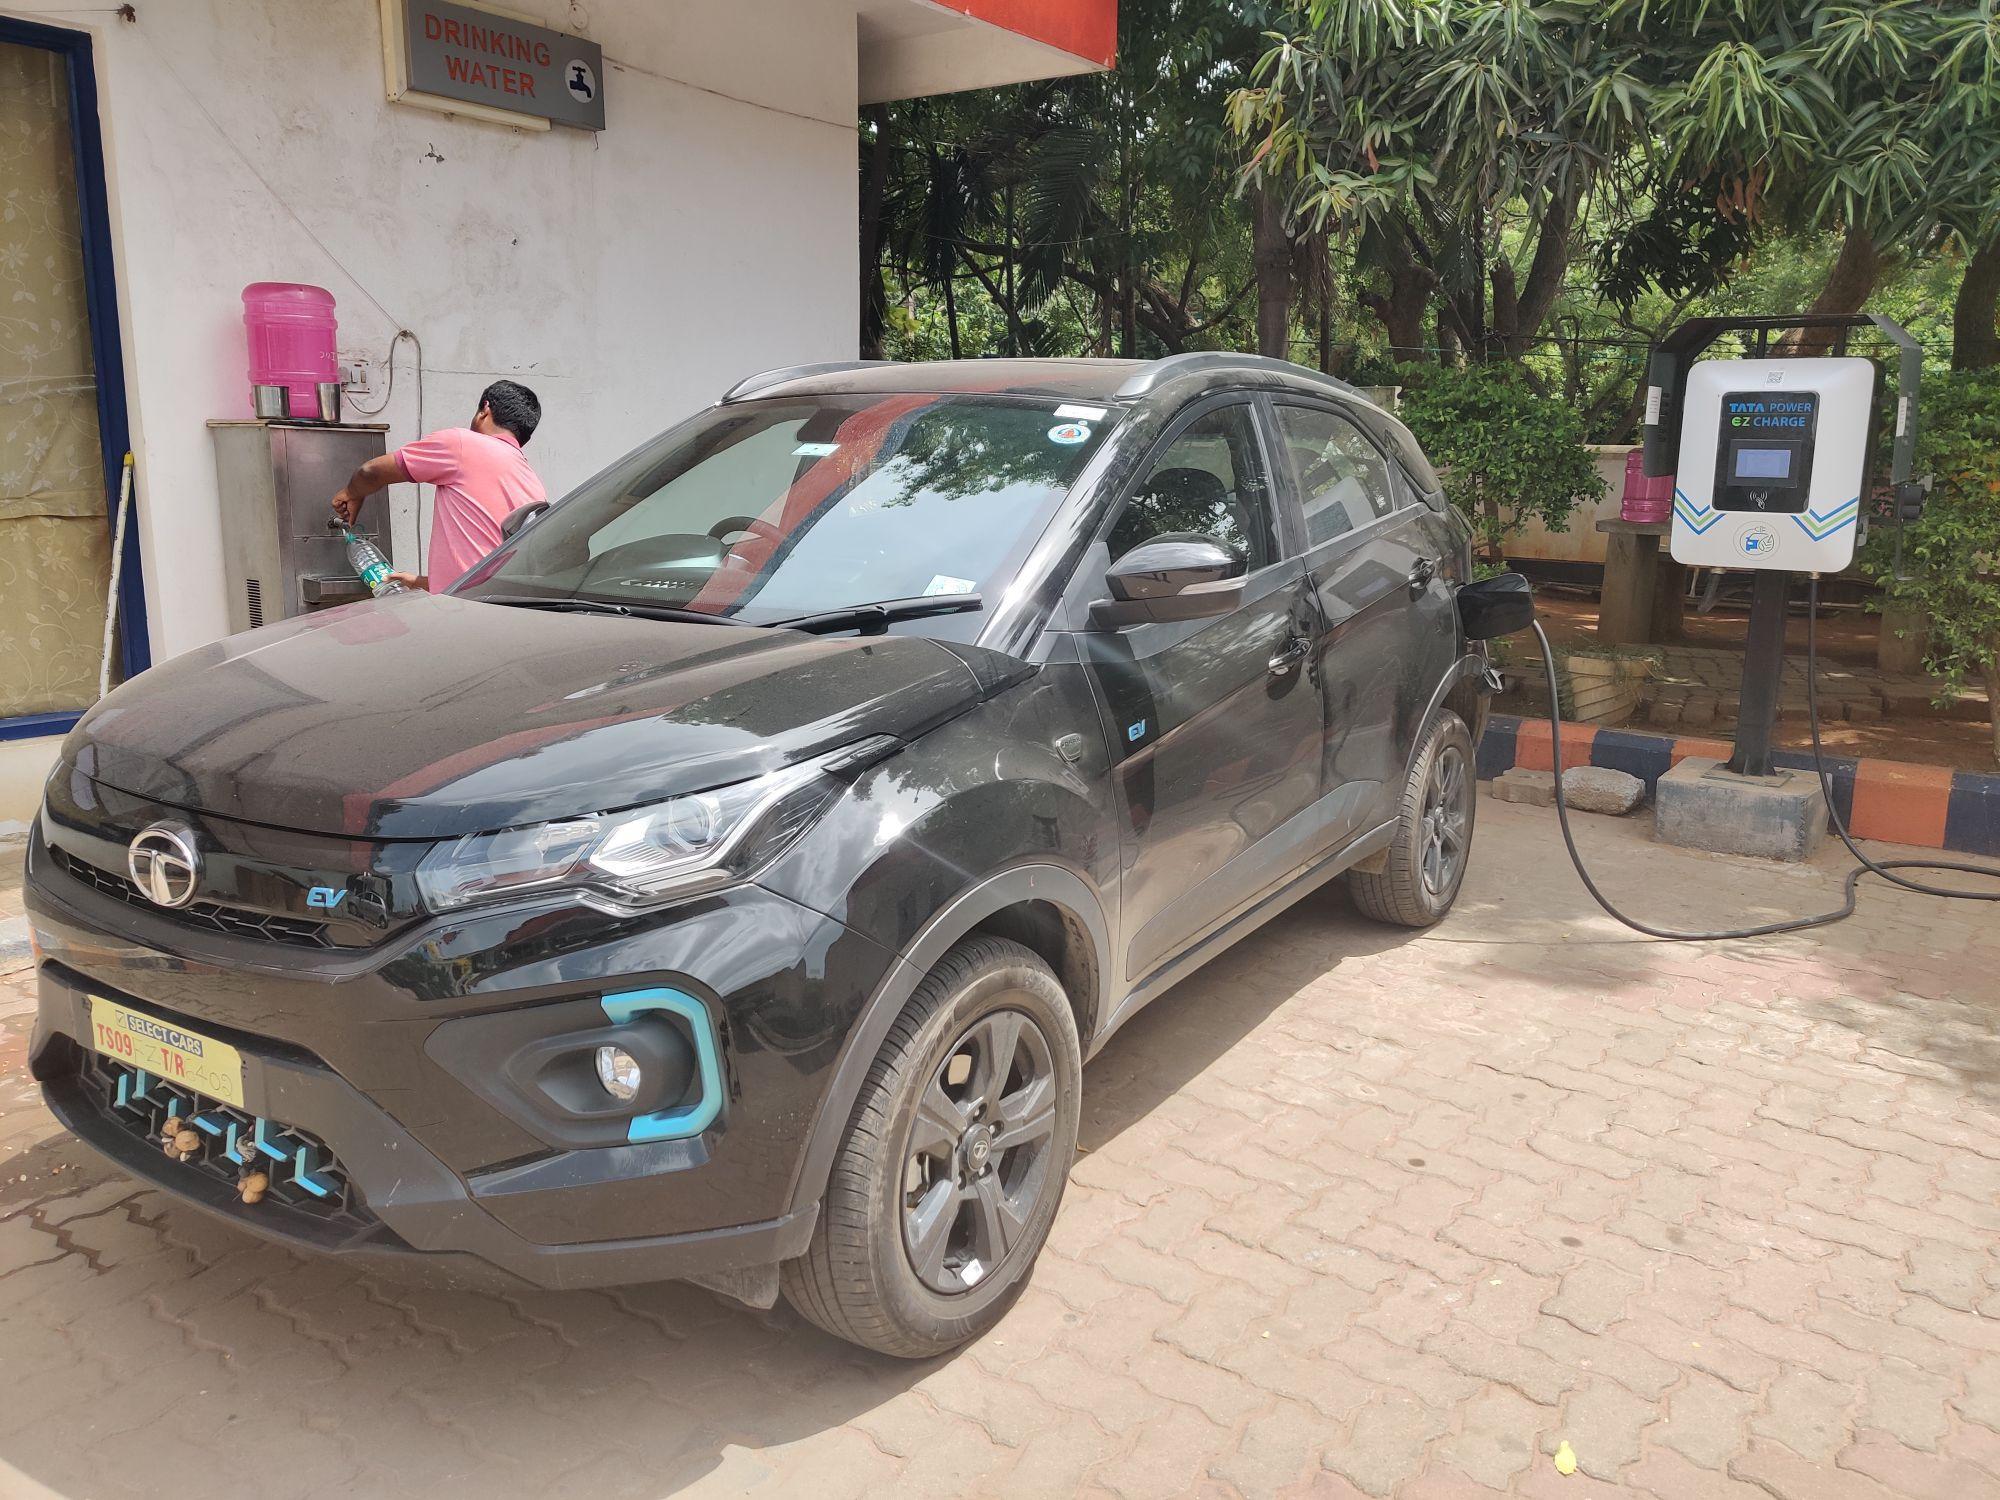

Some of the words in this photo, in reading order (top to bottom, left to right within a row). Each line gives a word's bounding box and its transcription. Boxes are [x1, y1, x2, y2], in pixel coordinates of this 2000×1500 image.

[425, 13, 551, 67] DRINKING
[444, 54, 536, 98] WATER
[1729, 402, 1765, 413] TATA
[1769, 402, 1812, 413] POWER
[1753, 416, 1806, 427] CHARGE
[306, 886, 349, 909] EV
[96, 1023, 133, 1057] TS09
[128, 1015, 168, 1042] SELECT
[169, 1031, 202, 1056] CARS
